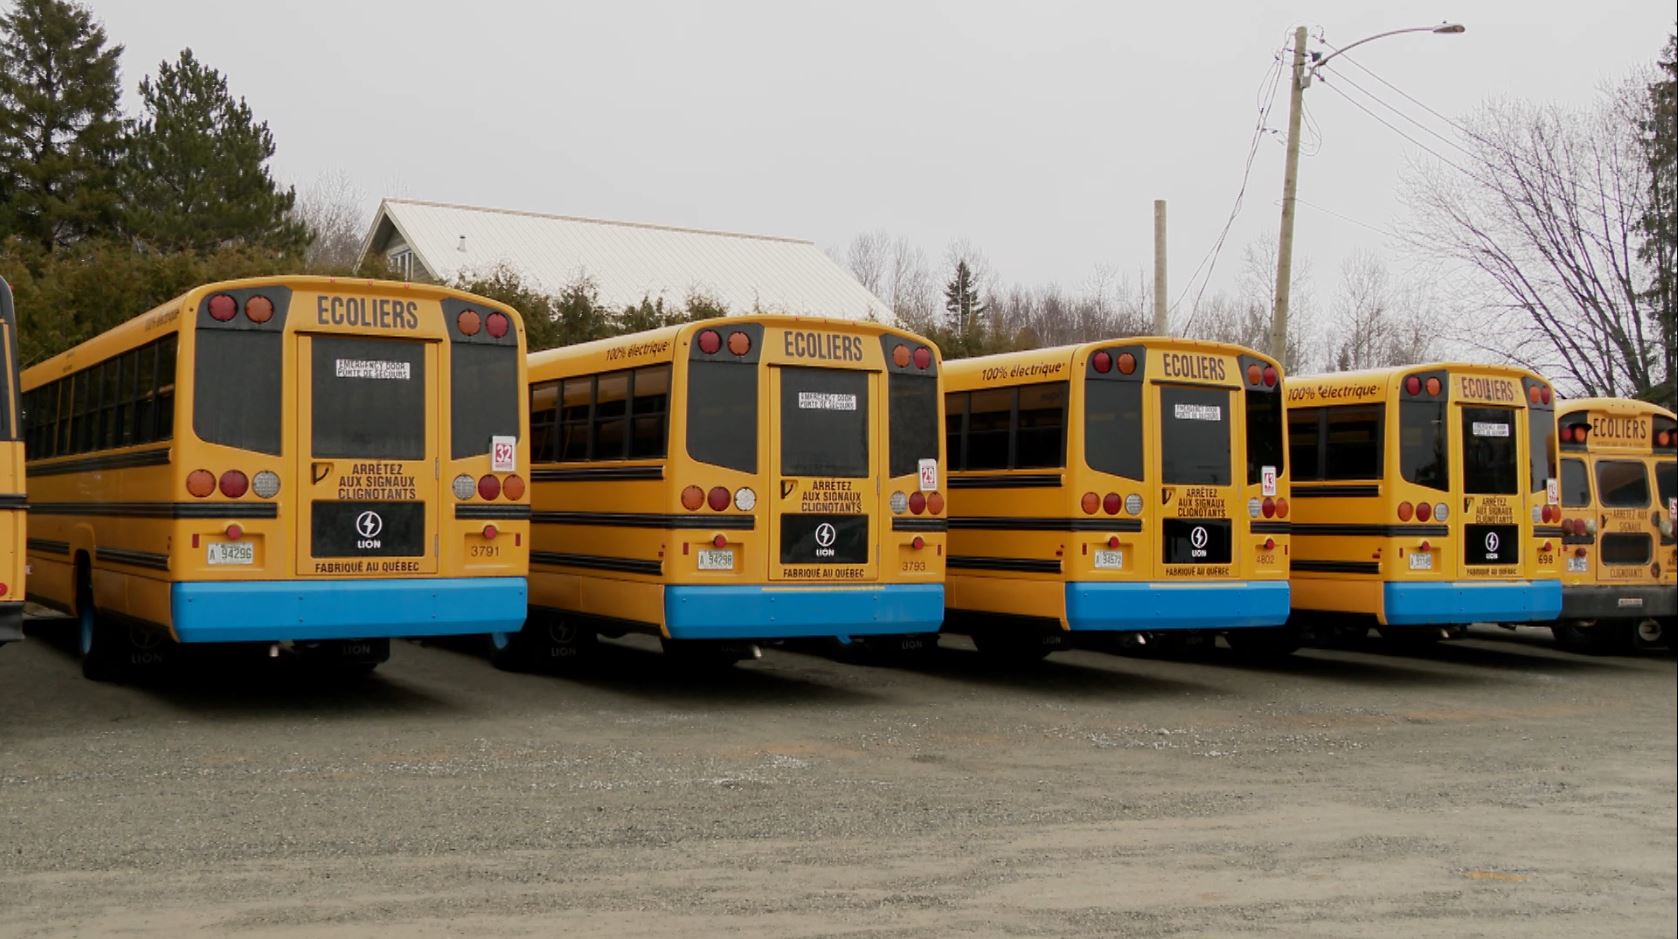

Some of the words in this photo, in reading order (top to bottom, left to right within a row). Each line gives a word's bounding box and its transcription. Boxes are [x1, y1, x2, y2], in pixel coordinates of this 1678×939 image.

[317, 295, 418, 330] ECOLIERS
[784, 331, 863, 362] ECOLIERS
[982, 366, 1008, 381] 100%
[1010, 361, 1062, 378] électrique
[1163, 353, 1226, 381] ECOLIERS
[1288, 386, 1316, 401] 100%
[1461, 376, 1514, 401] ECOLIERS
[1593, 418, 1647, 439] ECOLIERS
[495, 443, 513, 462] 32
[922, 467, 935, 484] 29
[338, 476, 363, 488] AUX
[366, 476, 416, 488] SIGNAUX
[338, 488, 416, 500] CLIGNOTANTS
[802, 491, 821, 501] AUX
[823, 491, 862, 502] SIGNAUX
[801, 502, 862, 513] CLIGNOTANTS
[1178, 499, 1193, 507] AUX
[1194, 499, 1225, 508] SIGNAUX
[1177, 507, 1226, 517] CLIGNOTANTS
[357, 540, 382, 549] LION
[210, 549, 216, 561] A
[471, 545, 500, 558] 3791
[816, 549, 835, 557] LION
[1191, 549, 1207, 558] LION
[1538, 554, 1553, 564] 698
[315, 560, 364, 573] FABRIQUÉ
[366, 562, 379, 572] AU
[382, 560, 420, 572] QUÉBEC
[822, 569, 833, 578] AU
[835, 567, 865, 578] QUÉBEC
[902, 561, 926, 572] 3793
[342, 644, 371, 656] LION
[551, 647, 577, 657] LION
[131, 653, 163, 665] LION
